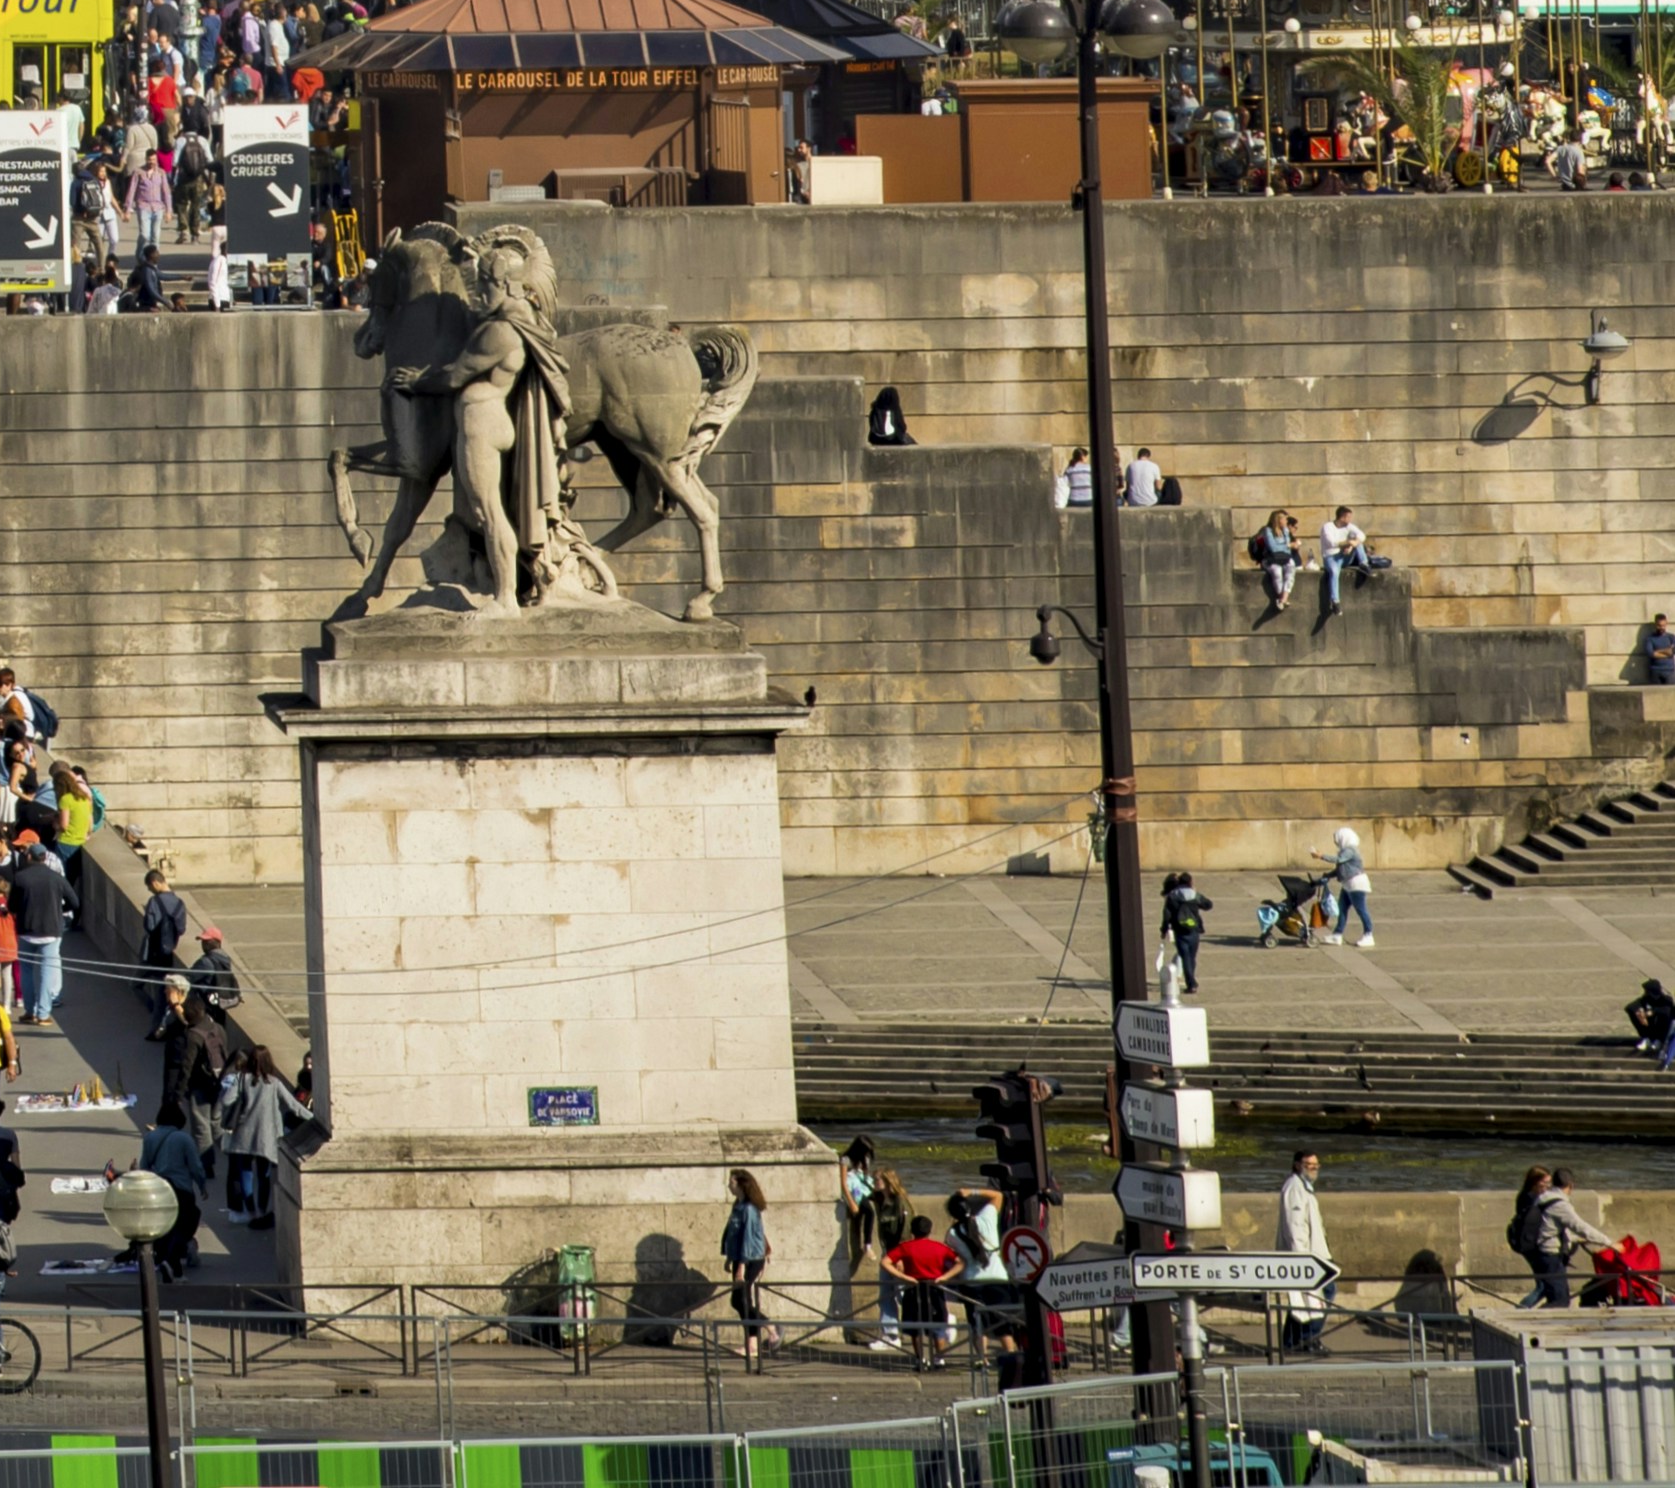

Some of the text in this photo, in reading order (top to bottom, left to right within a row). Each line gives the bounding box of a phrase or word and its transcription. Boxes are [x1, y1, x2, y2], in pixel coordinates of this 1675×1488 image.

[368, 72, 438, 89] LE CARROUSEL
[457, 69, 700, 89] LE CARROUSEL DE LA TOUR EIFFEL
[718, 67, 778, 85] LE CARROUSEL
[231, 153, 294, 166] CROISIERES
[231, 166, 277, 177] CRUISES
[1133, 1014, 1169, 1035] INVALIDES
[1129, 1036, 1170, 1056] CAMBRONNE
[548, 1095, 579, 1104] PLACE
[1143, 1101, 1152, 1113] du
[537, 1107, 591, 1117] DE VARSOVIE
[1050, 1268, 1109, 1287] Navettes
[1140, 1264, 1201, 1280] PORTE
[1254, 1264, 1315, 1280] CLOUD
